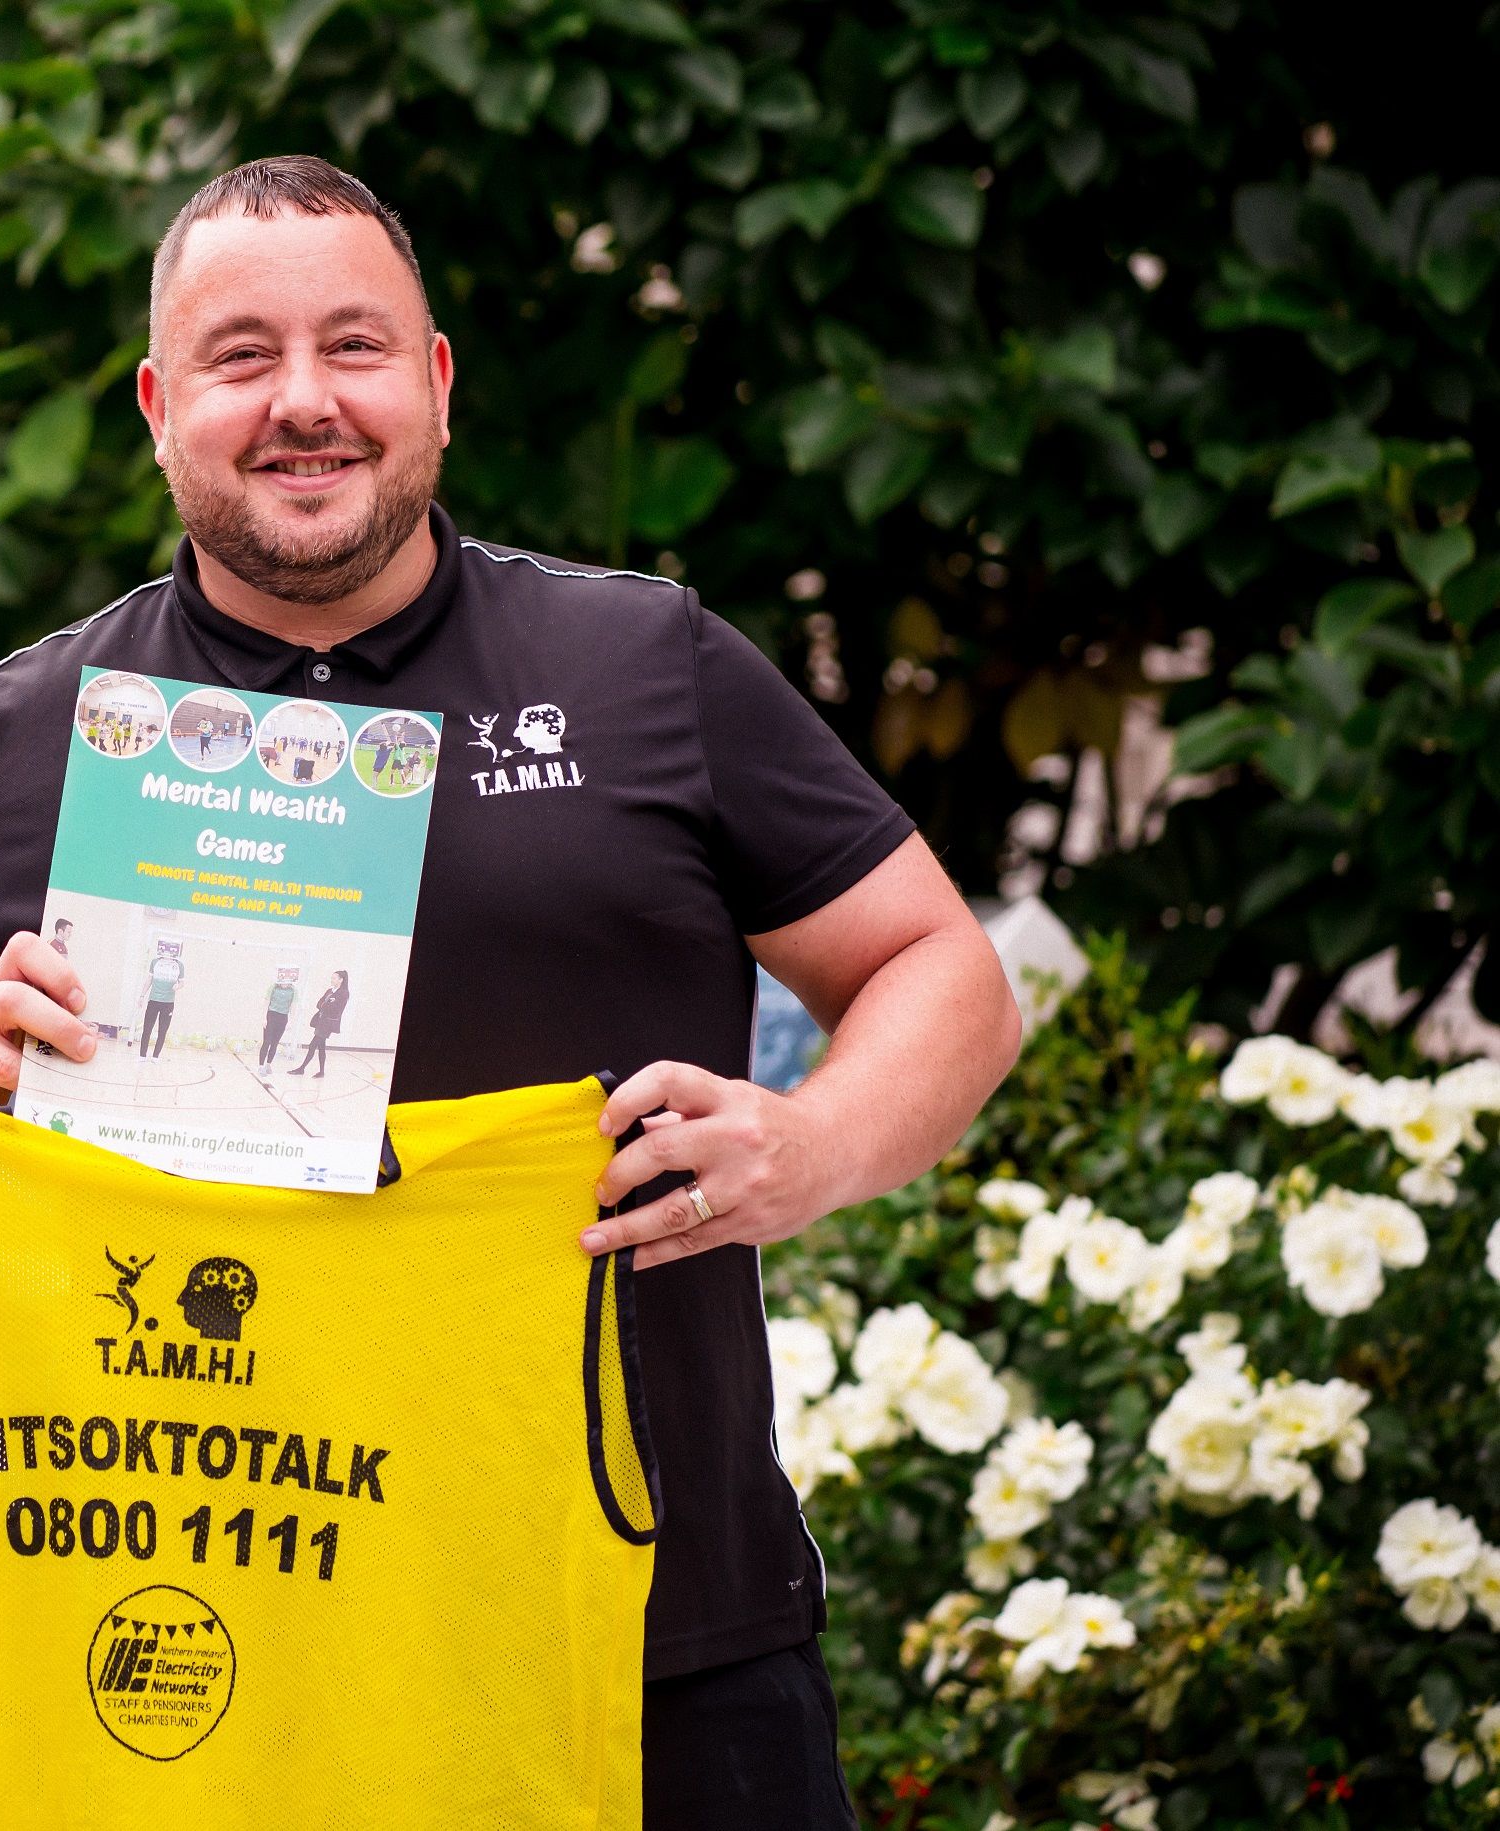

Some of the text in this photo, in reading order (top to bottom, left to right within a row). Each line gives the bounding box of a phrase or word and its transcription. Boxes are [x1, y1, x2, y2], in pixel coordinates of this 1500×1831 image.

[470, 761, 583, 797] T.A.M.H.I
[141, 772, 347, 825] Mental Wealth
[196, 829, 287, 865] Games
[137, 862, 363, 903] PROMOTE MENTAL HEALTH THROUGH
[191, 892, 303, 917] GAMES AND PLAY
[98, 1124, 304, 1158] www.tamhi.org/education
[94, 1336, 257, 1386] T.A.M.H.I
[6, 1496, 340, 1582] 0800 1111
[159, 1645, 227, 1659] Northern Ireland
[155, 1659, 223, 1680] Electricity
[151, 1679, 208, 1696] Networks
[104, 1698, 212, 1713] STAFF & PENSIONERS
[118, 1714, 198, 1728] CHARITIES FUND
